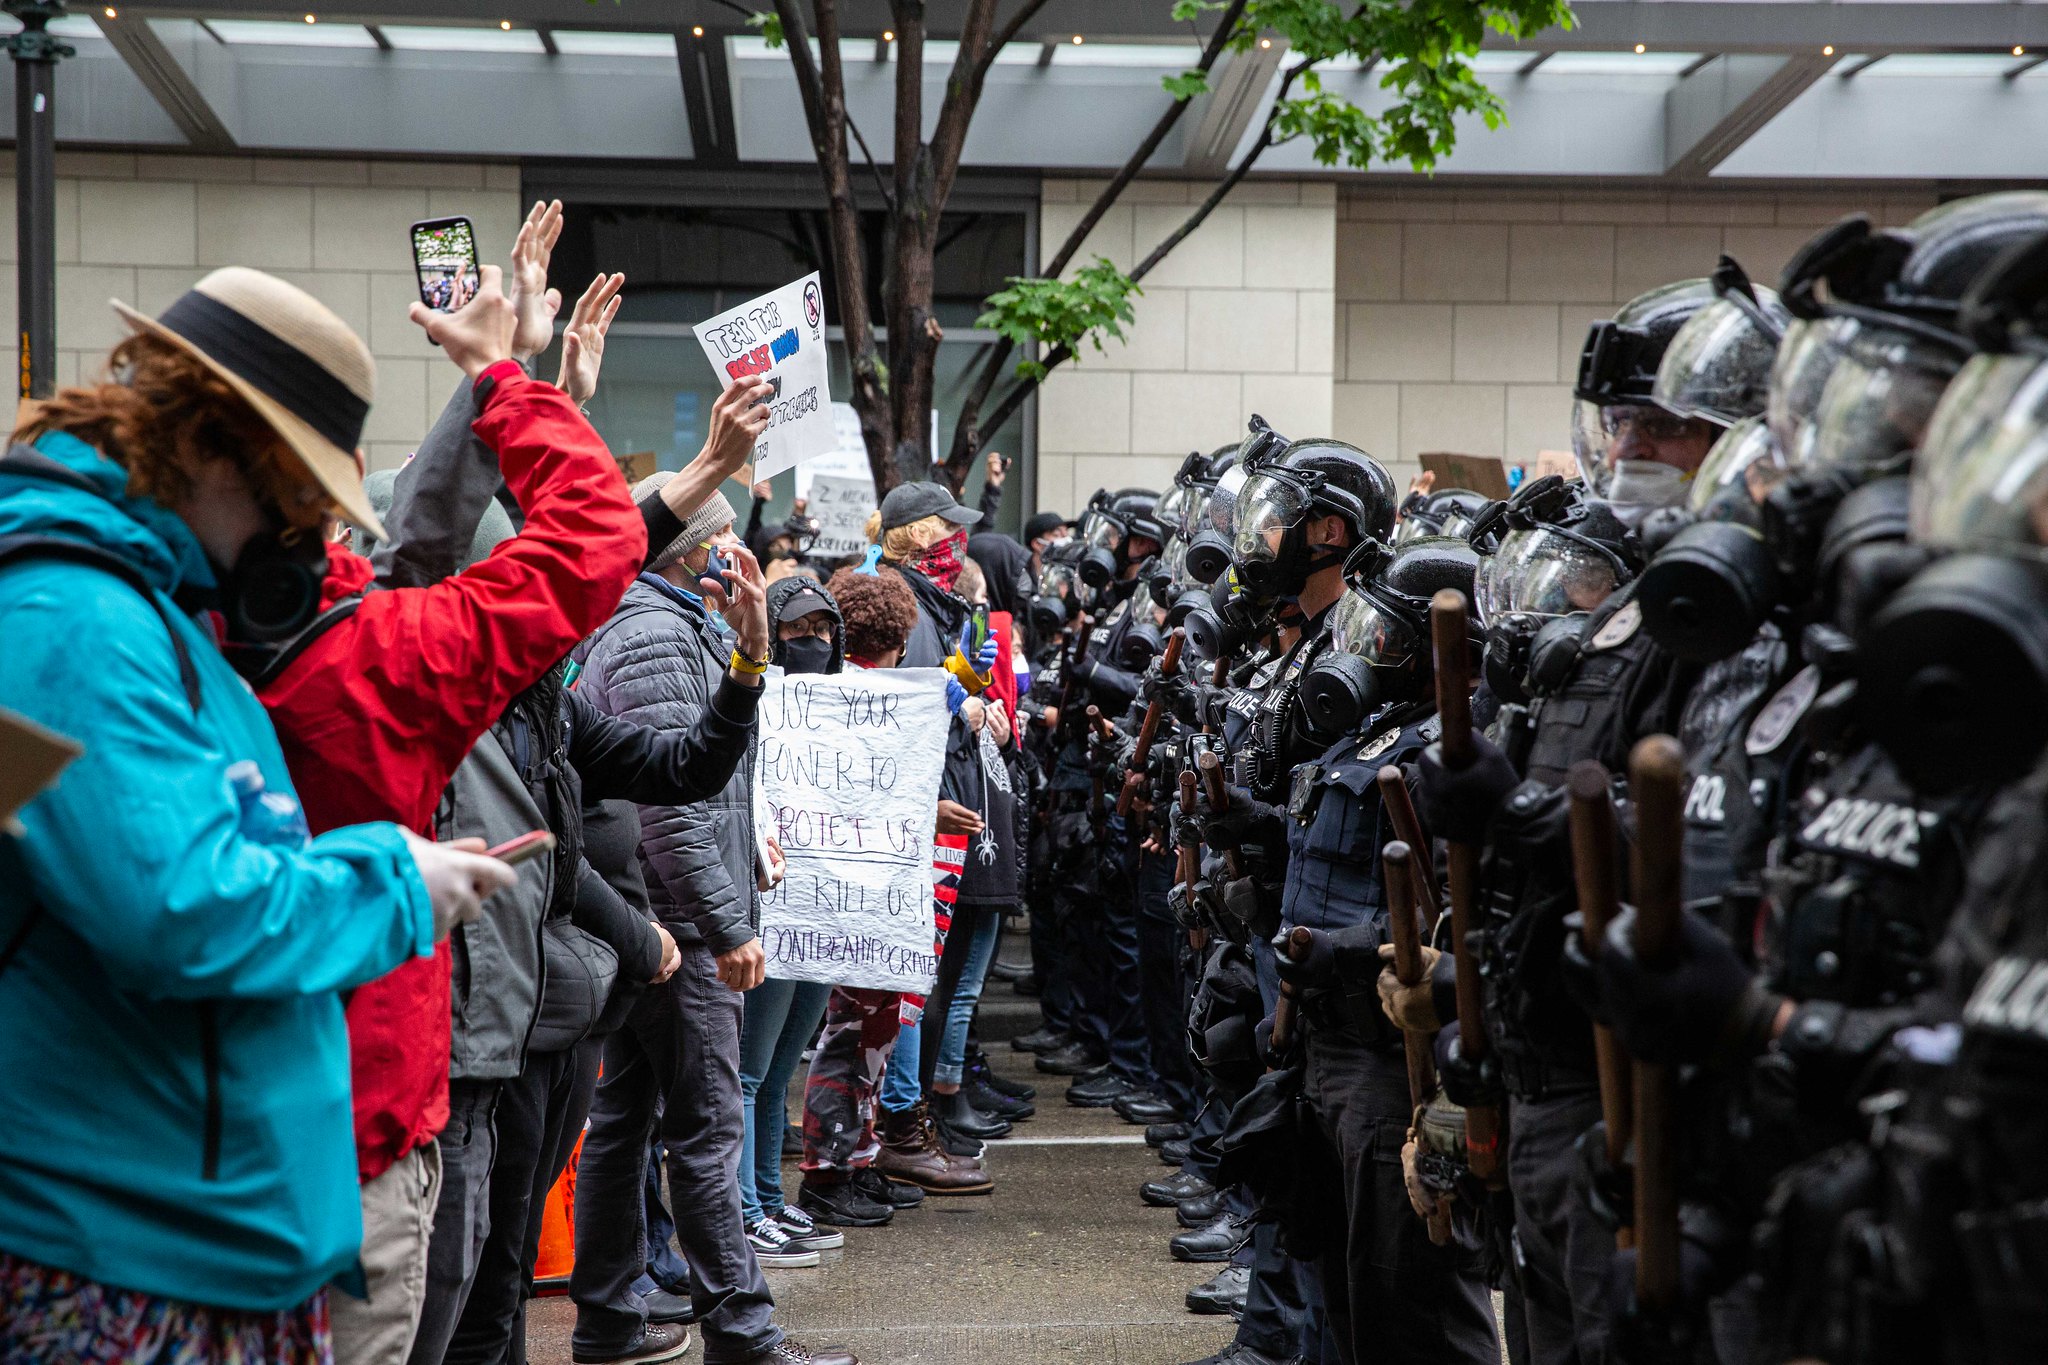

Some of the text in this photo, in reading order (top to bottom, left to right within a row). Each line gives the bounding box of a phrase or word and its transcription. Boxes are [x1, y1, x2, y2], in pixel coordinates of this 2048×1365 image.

[705, 316, 757, 358] TEAR
[761, 682, 901, 731] USE YOUR
[760, 737, 897, 791] POWER TO
[887, 818, 919, 857] US
[1802, 798, 1938, 868] POLICE
[814, 876, 868, 912] KILL
